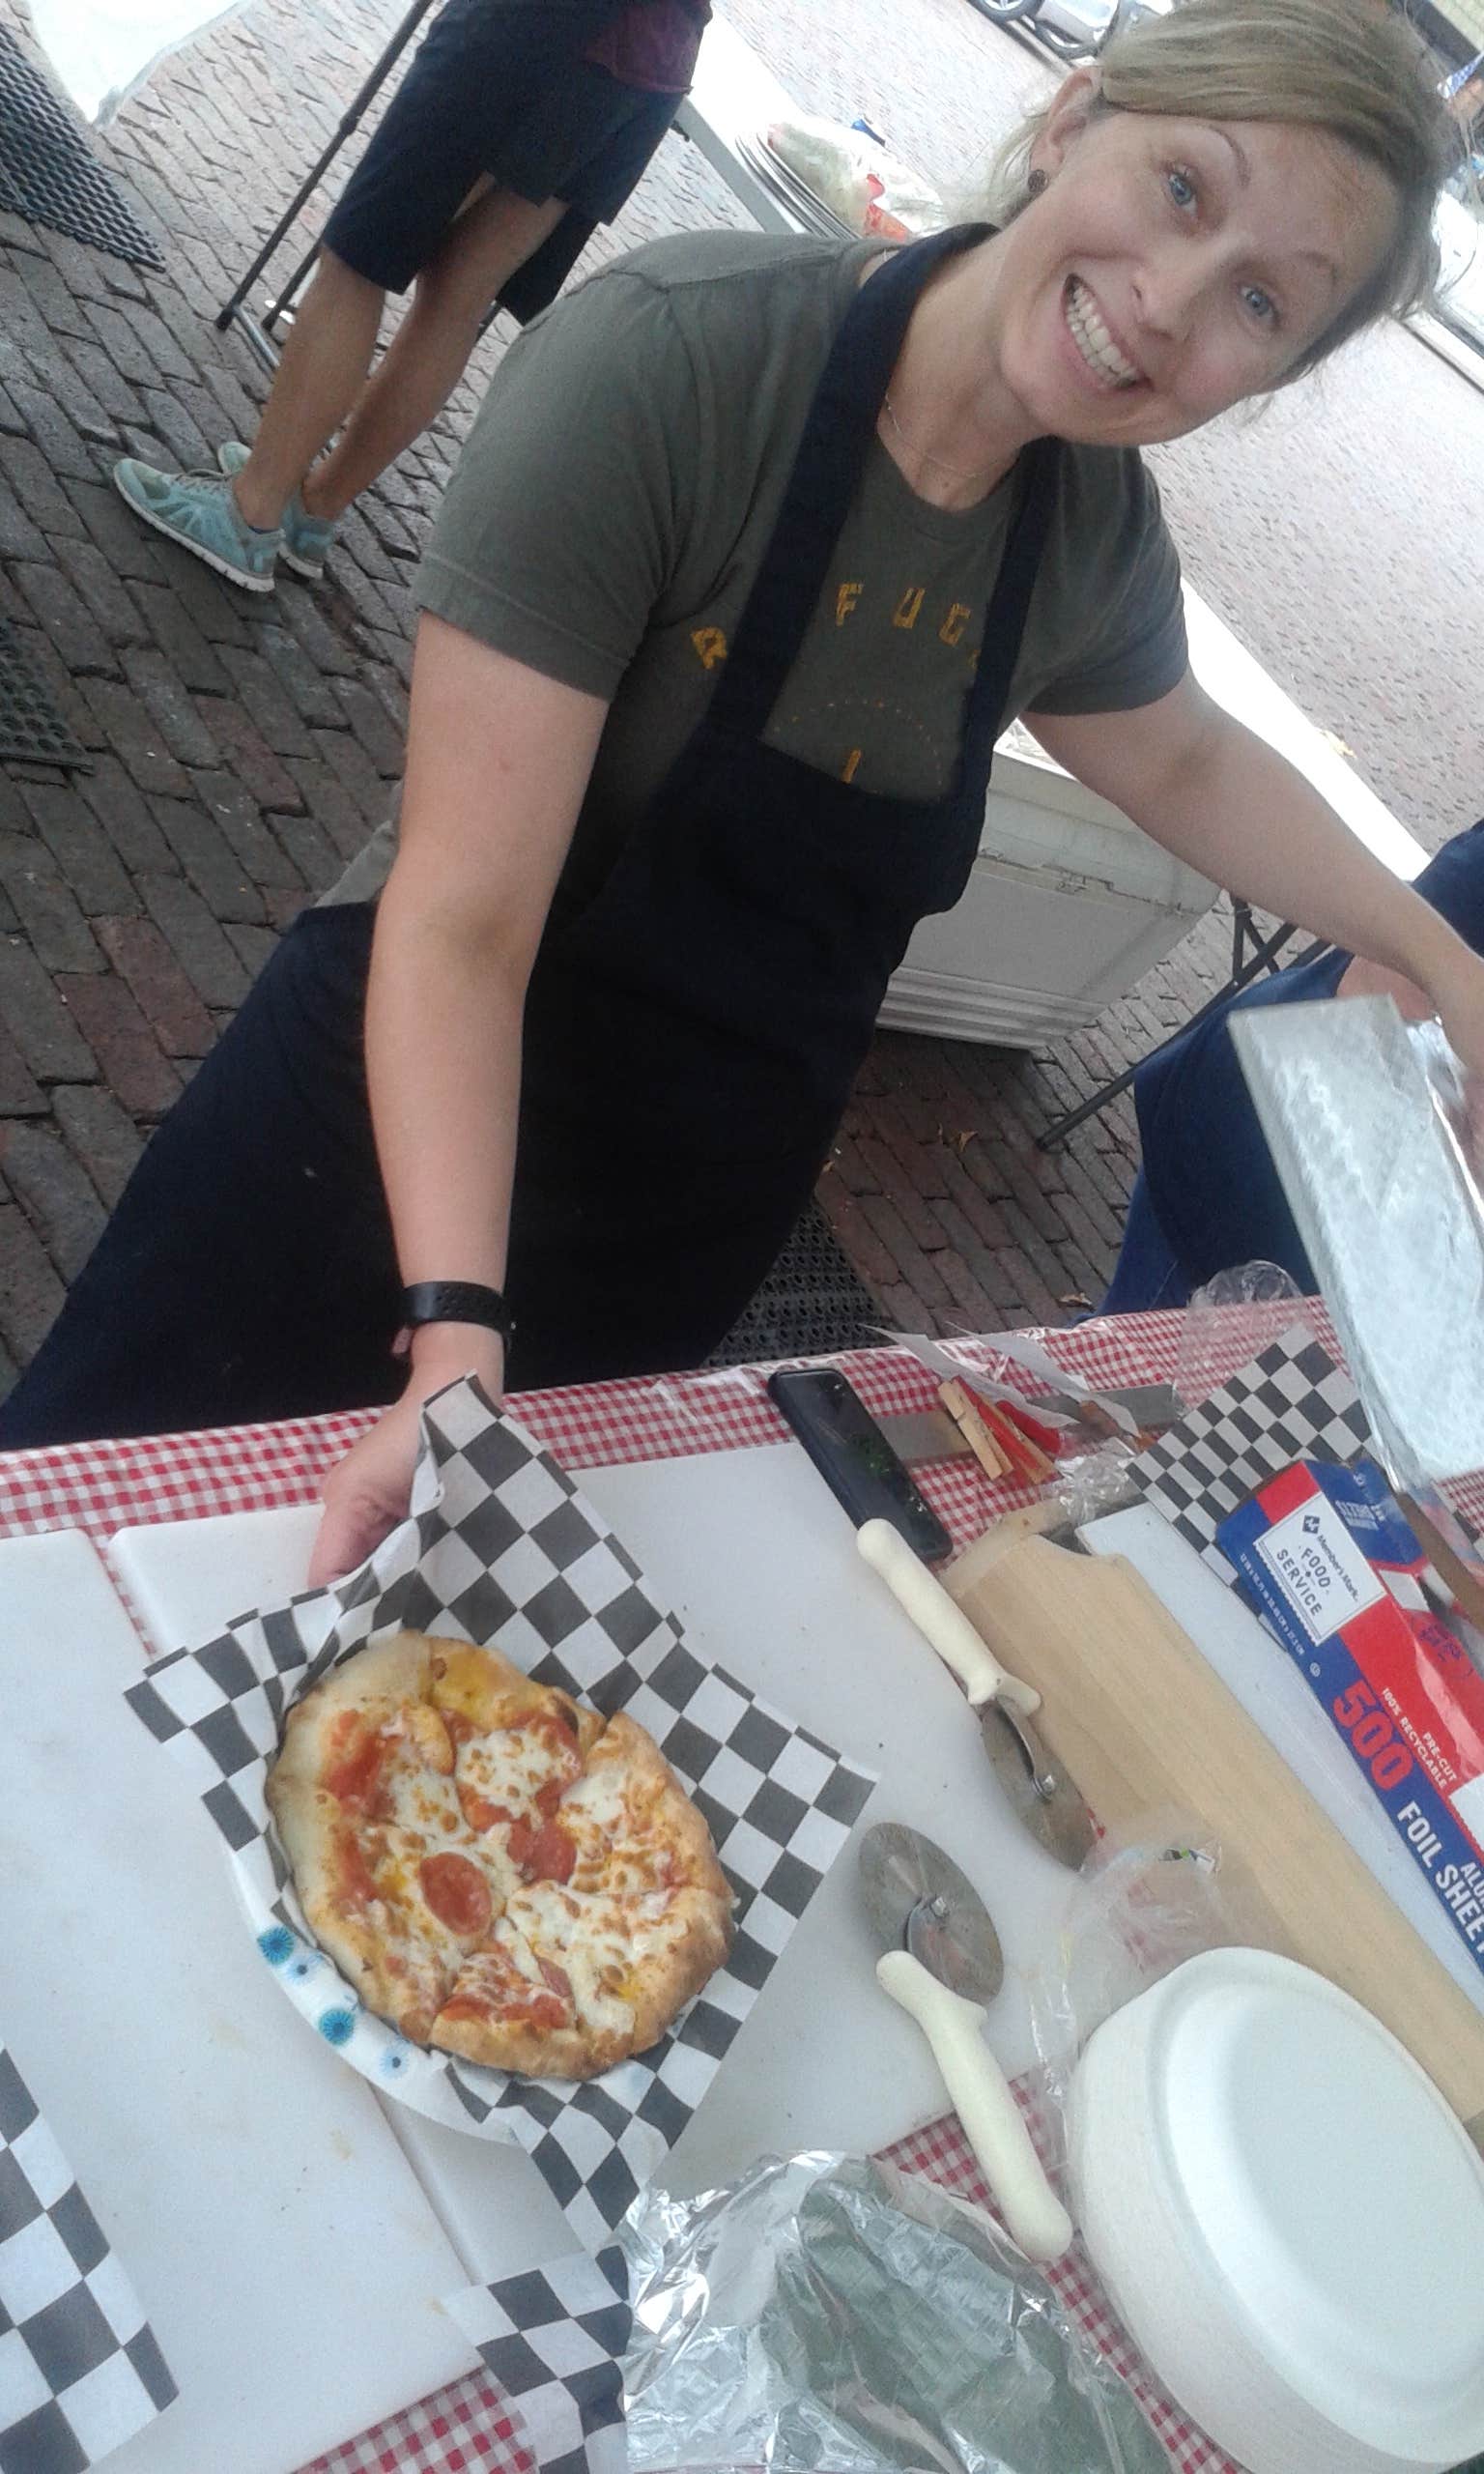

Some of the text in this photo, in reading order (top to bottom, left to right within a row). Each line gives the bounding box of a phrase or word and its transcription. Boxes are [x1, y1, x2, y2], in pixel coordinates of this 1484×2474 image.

[1276, 1549, 1322, 1616] SERVICE
[1301, 1548, 1330, 1588] FOOD
[1333, 1680, 1413, 1791] 500
[1383, 1687, 1447, 1789] 100% RECYCLABLE
[1422, 1732, 1457, 1781] PRE-CUT
[1397, 1800, 1442, 1868] FOIL
[1460, 1861, 1484, 1910] ALU
